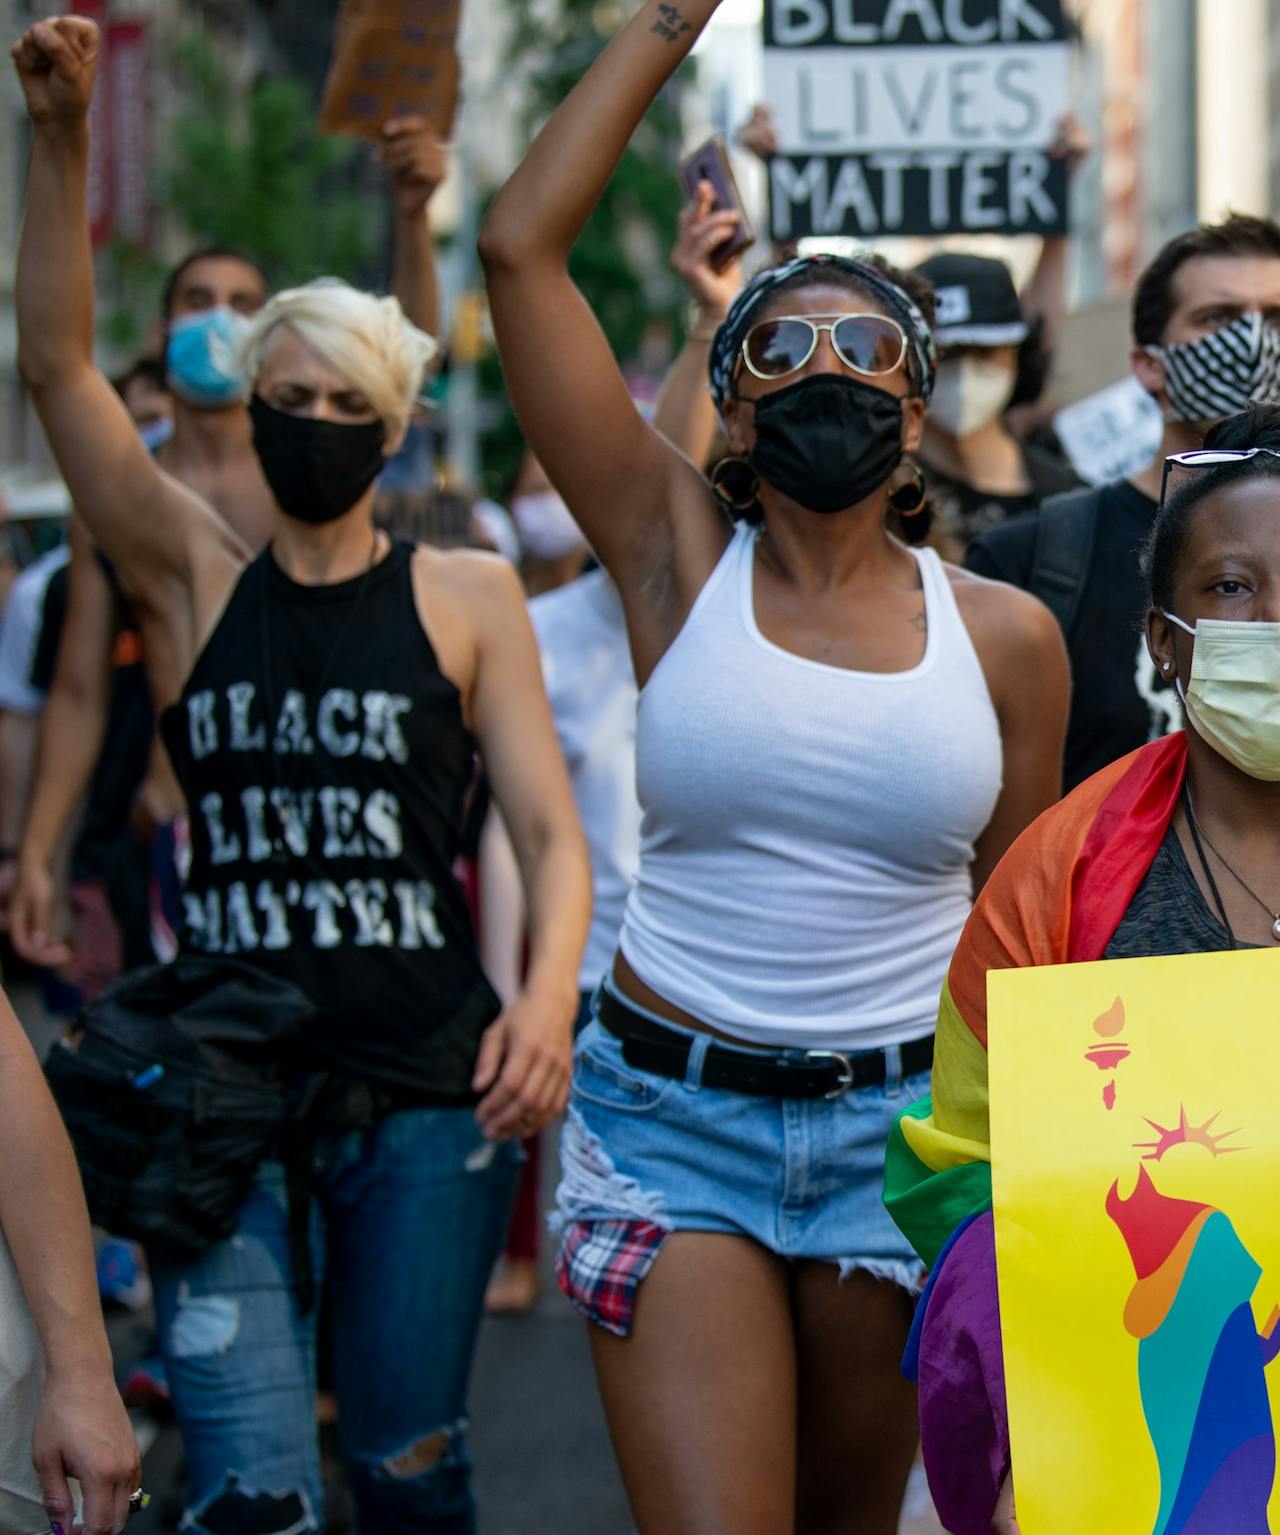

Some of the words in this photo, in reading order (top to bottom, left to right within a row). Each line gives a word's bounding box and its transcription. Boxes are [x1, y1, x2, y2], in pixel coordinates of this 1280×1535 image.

[772, 0, 1054, 45] BLACK
[797, 57, 1040, 142] LIVES
[770, 153, 1057, 238] MATTER
[188, 681, 412, 765] BLACK
[201, 785, 403, 864] LIVES
[184, 879, 445, 952] MATTER
